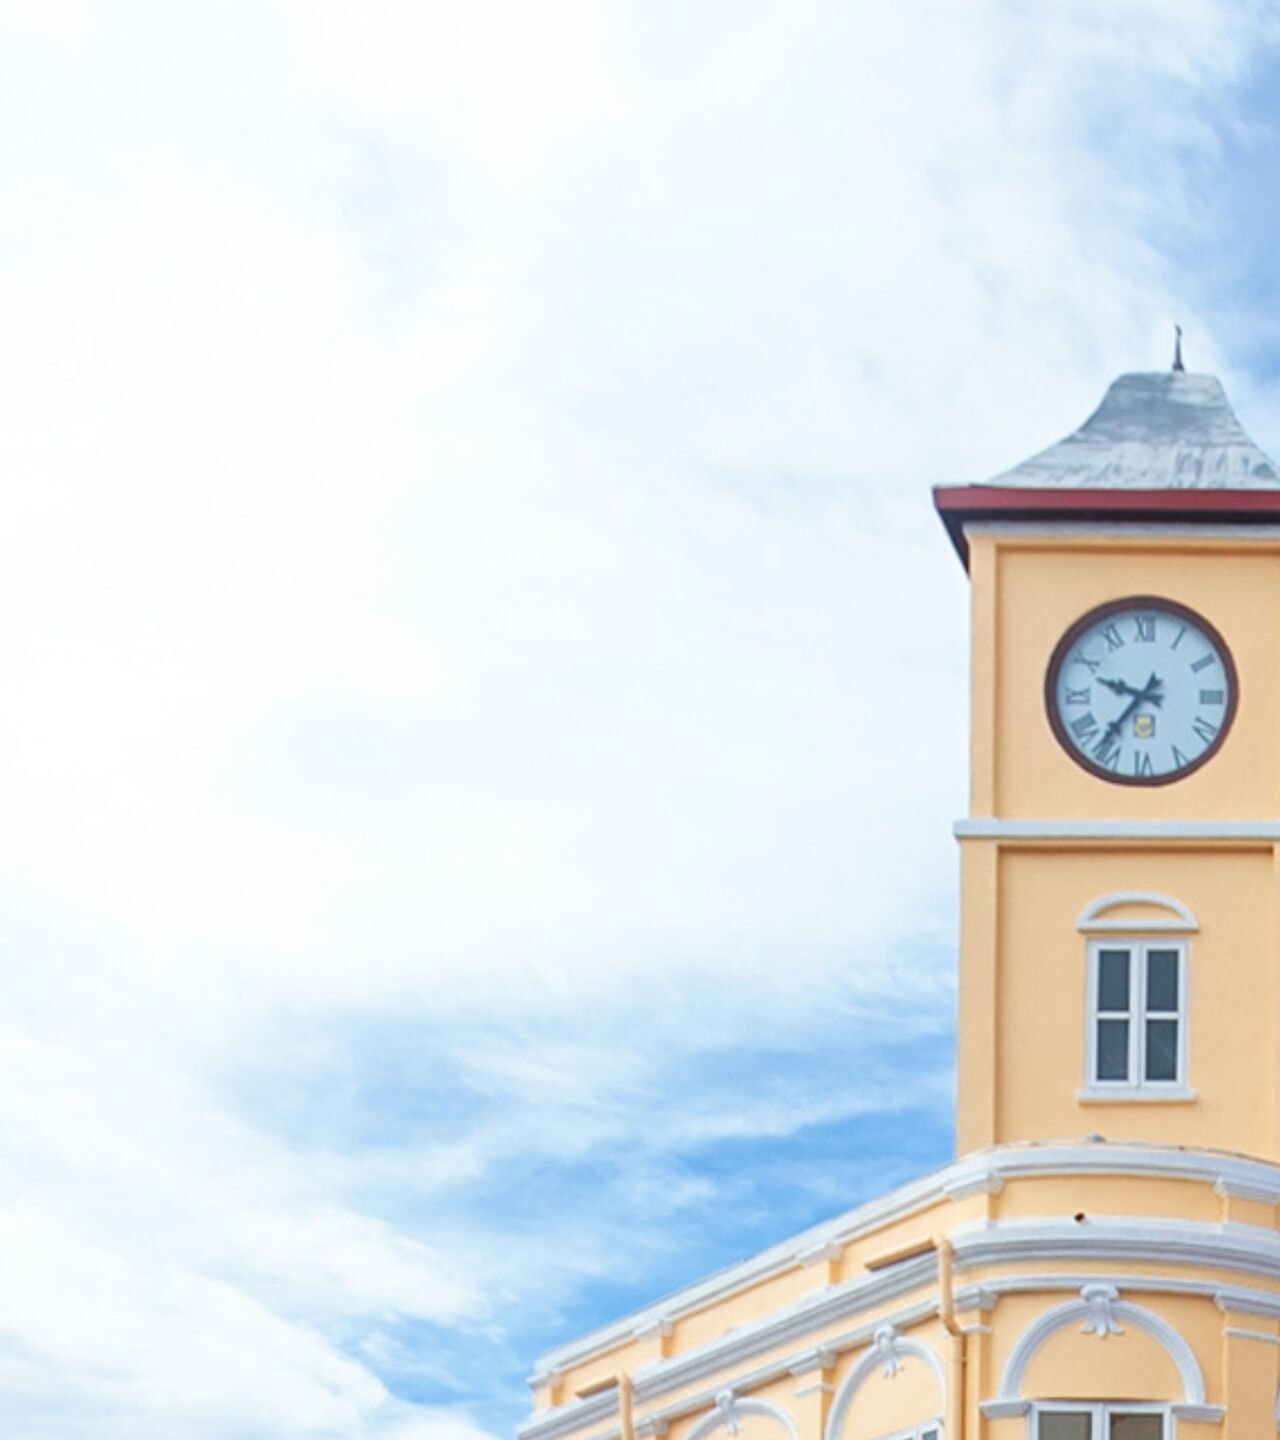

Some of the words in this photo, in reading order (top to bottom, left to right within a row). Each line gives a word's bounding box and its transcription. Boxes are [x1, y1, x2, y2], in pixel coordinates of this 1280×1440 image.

[1099, 623, 1124, 652] XI
[1134, 616, 1156, 642] XII
[1074, 651, 1100, 675] X
